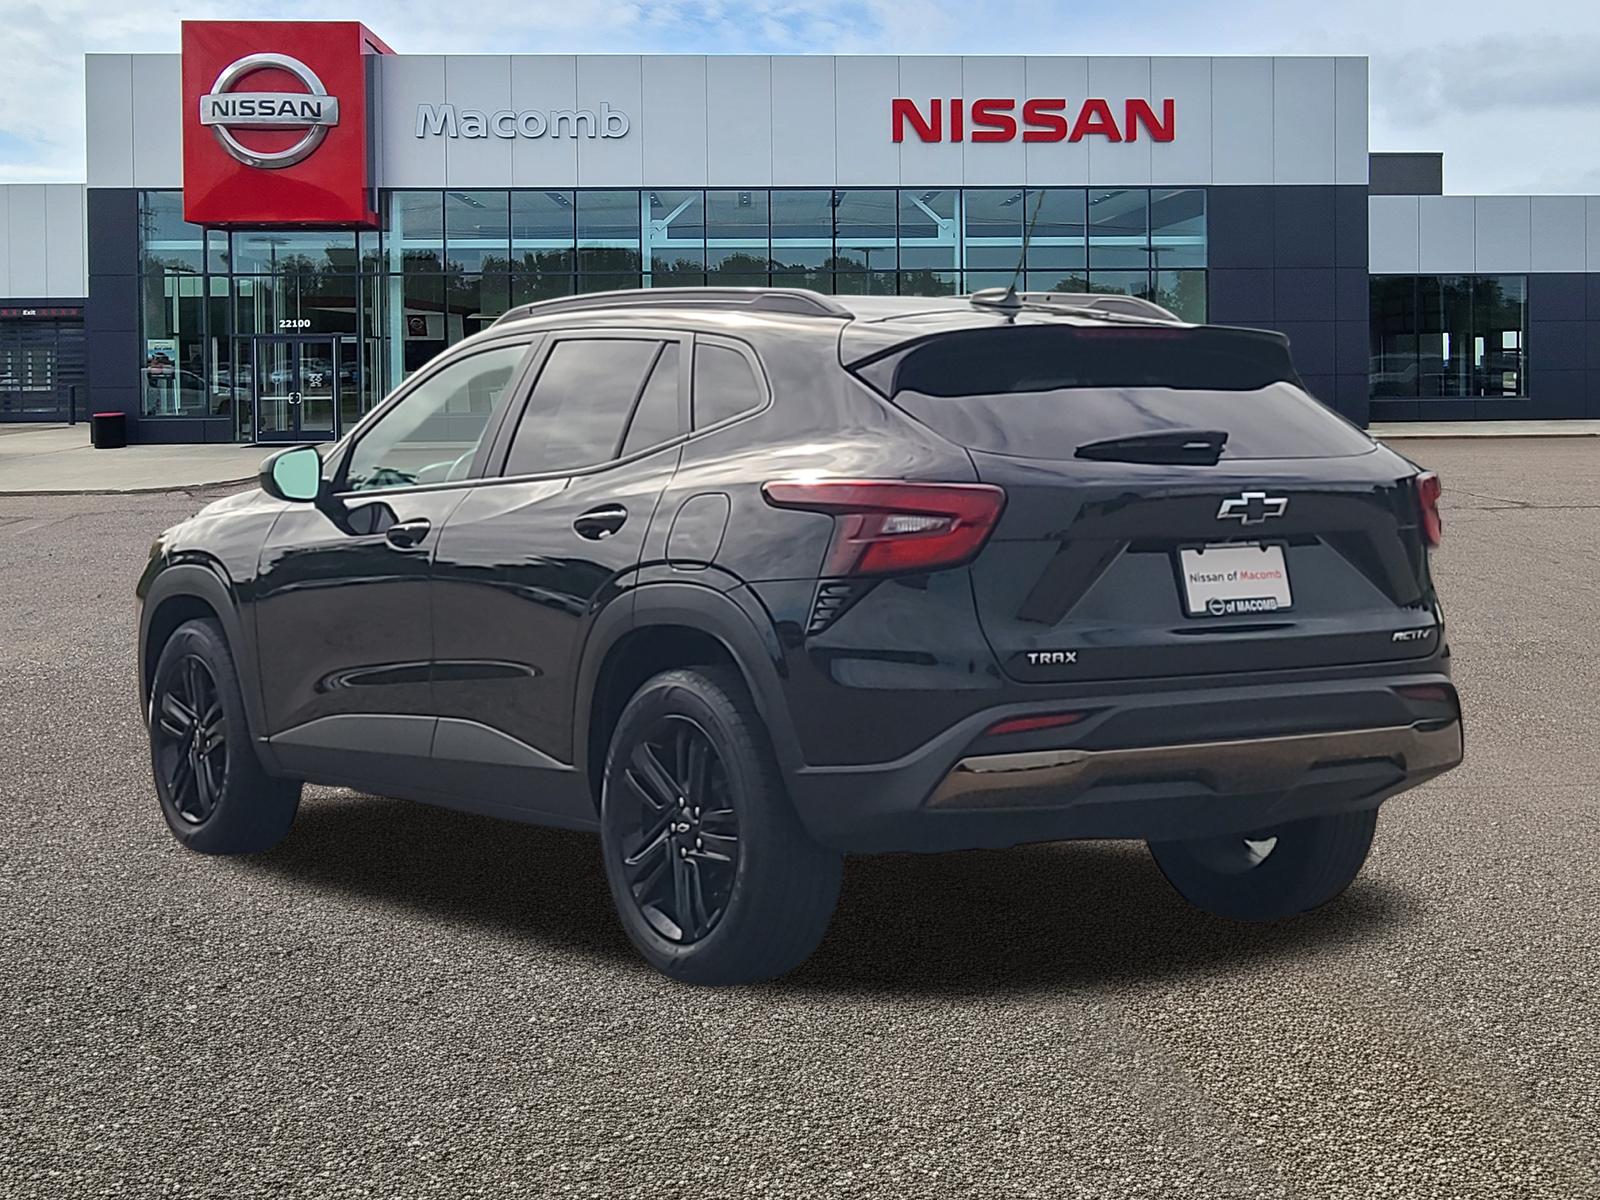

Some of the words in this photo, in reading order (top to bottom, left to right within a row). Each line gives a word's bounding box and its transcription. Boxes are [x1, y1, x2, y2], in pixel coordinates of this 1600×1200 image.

[211, 99, 322, 118] NISSAN
[415, 102, 630, 139] Macomb
[892, 98, 1175, 143] NISSAN
[279, 319, 311, 328] 22100
[1189, 572, 1224, 584] Nissan
[1227, 570, 1238, 581] of
[1240, 569, 1282, 581] Macomb
[1226, 603, 1236, 612] of
[1237, 599, 1277, 611] MACOMB
[1027, 651, 1077, 665] TRAX
